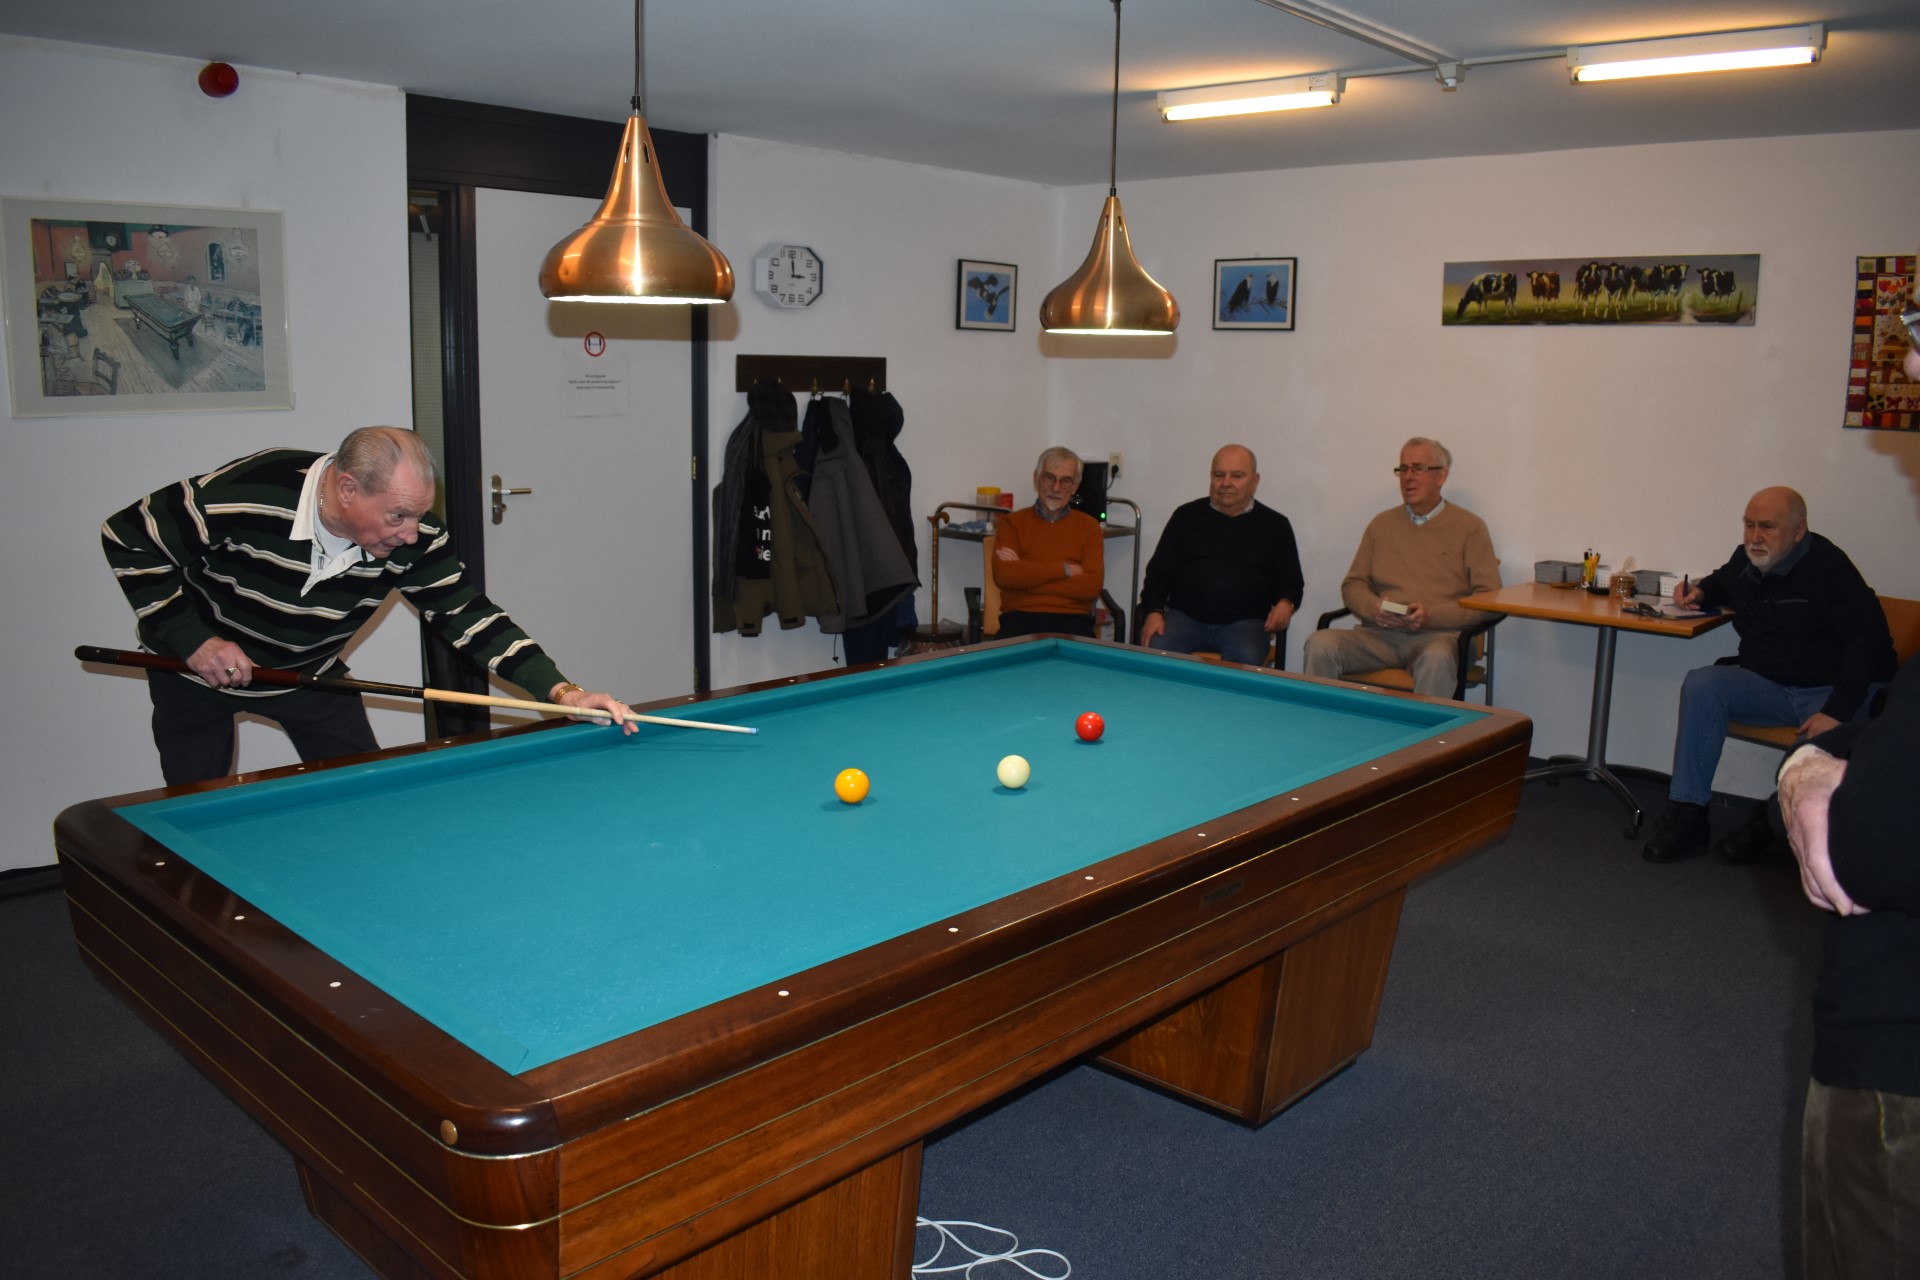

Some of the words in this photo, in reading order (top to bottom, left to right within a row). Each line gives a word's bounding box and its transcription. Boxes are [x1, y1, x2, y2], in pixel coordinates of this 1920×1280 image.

[810, 273, 817, 282] 3
[806, 286, 813, 295] 4
[779, 293, 786, 303] 7
[788, 293, 796, 303] 6
[797, 294, 805, 303] 5
